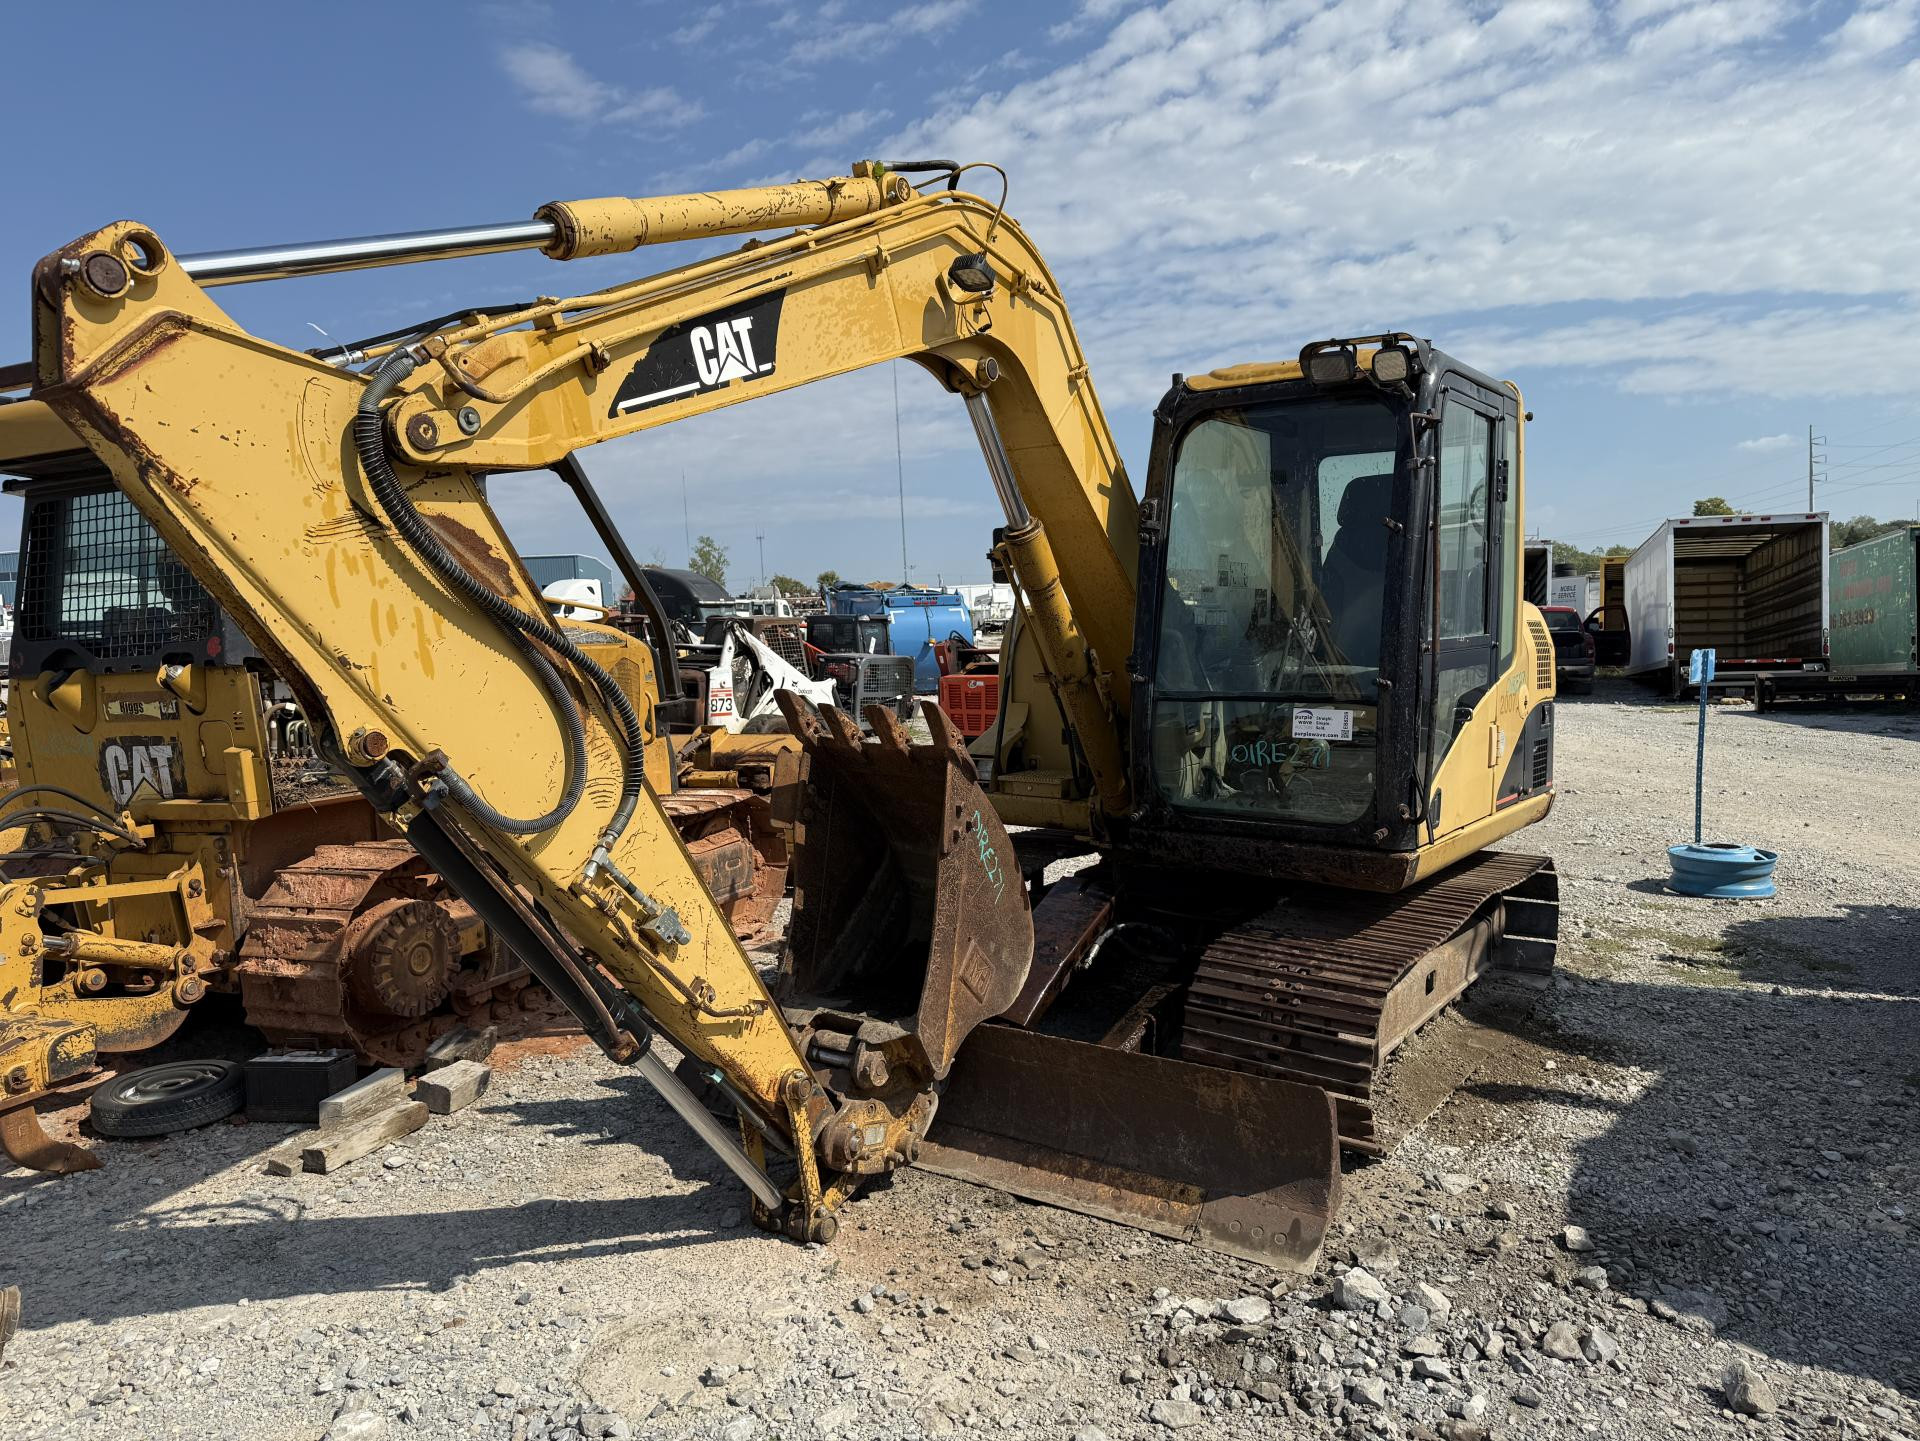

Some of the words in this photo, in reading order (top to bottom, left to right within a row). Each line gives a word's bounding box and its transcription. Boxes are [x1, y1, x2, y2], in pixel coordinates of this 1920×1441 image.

[690, 316, 758, 385] CAT
[711, 699, 732, 712] 873
[105, 745, 173, 806] CAT
